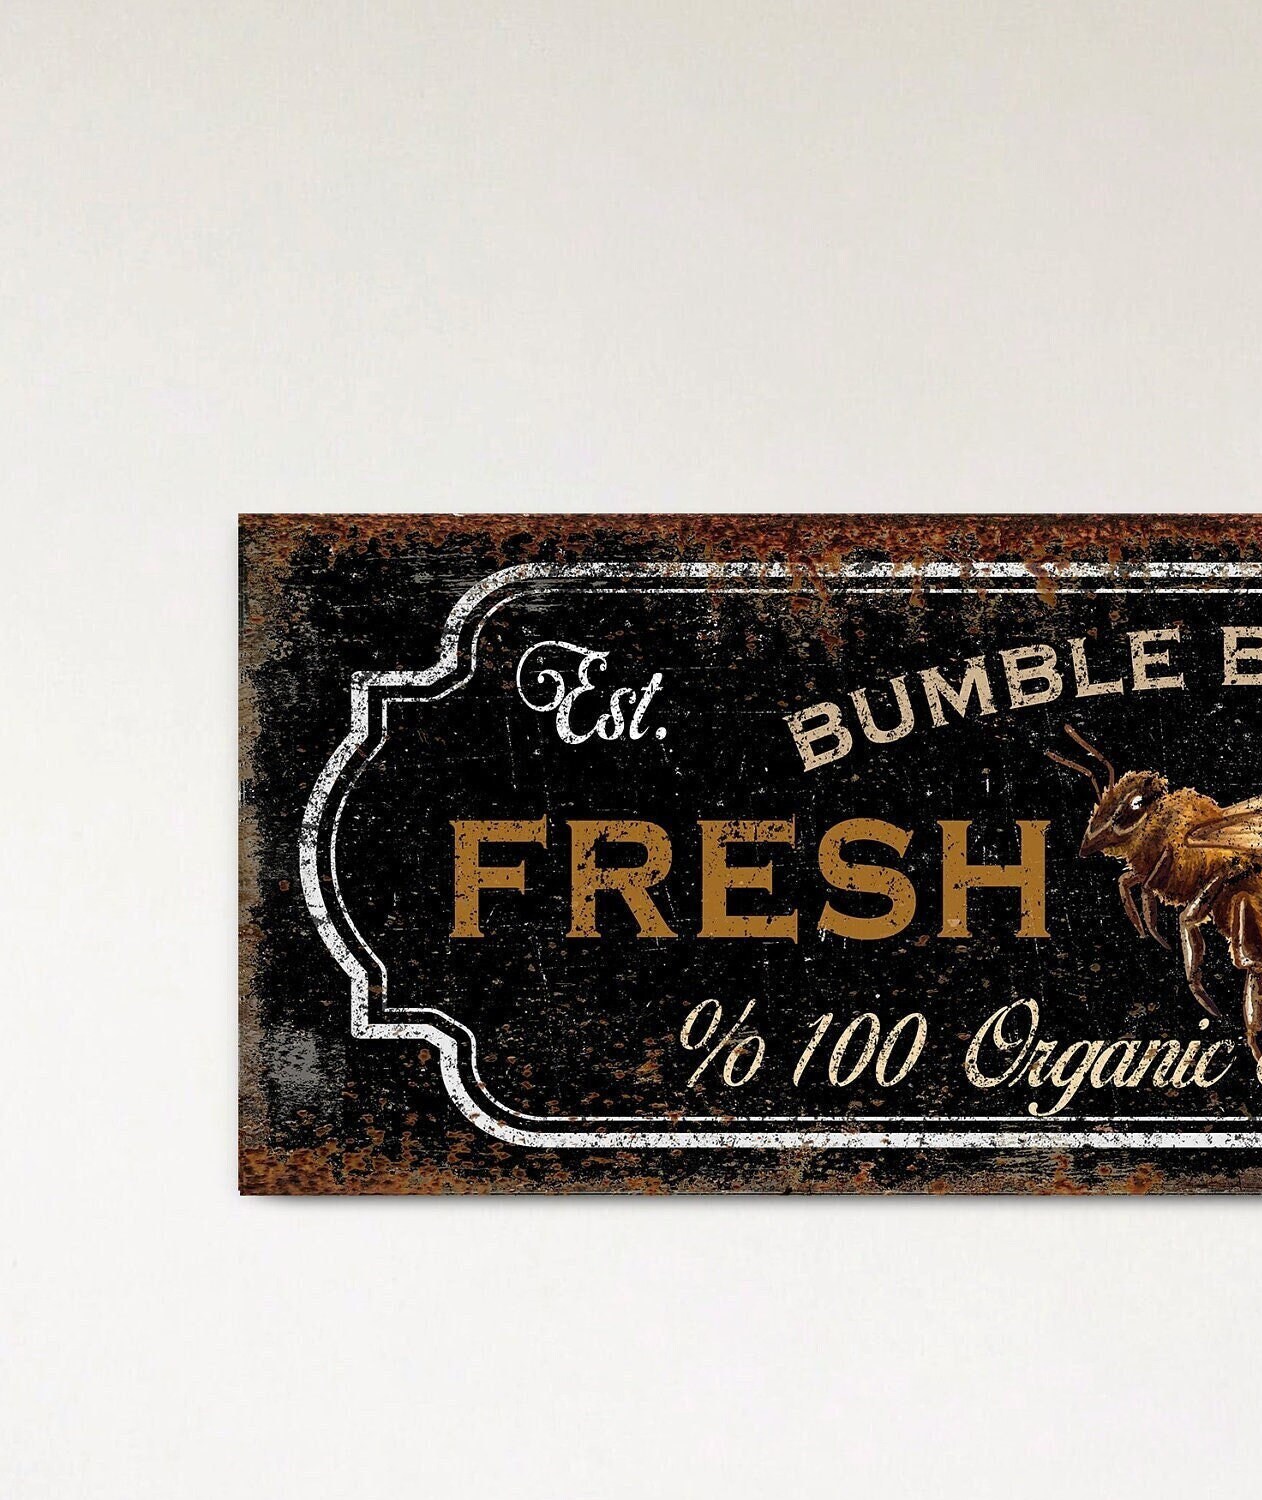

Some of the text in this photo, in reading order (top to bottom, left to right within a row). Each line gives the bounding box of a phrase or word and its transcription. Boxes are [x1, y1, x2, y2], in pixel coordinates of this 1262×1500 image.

[515, 640, 668, 745] Est.
[783, 626, 1186, 773] BUMBLE
[448, 813, 1051, 944] FRESH
[679, 998, 764, 1088] %
[791, 999, 928, 1088] 100
[963, 996, 1239, 1116] Organic
